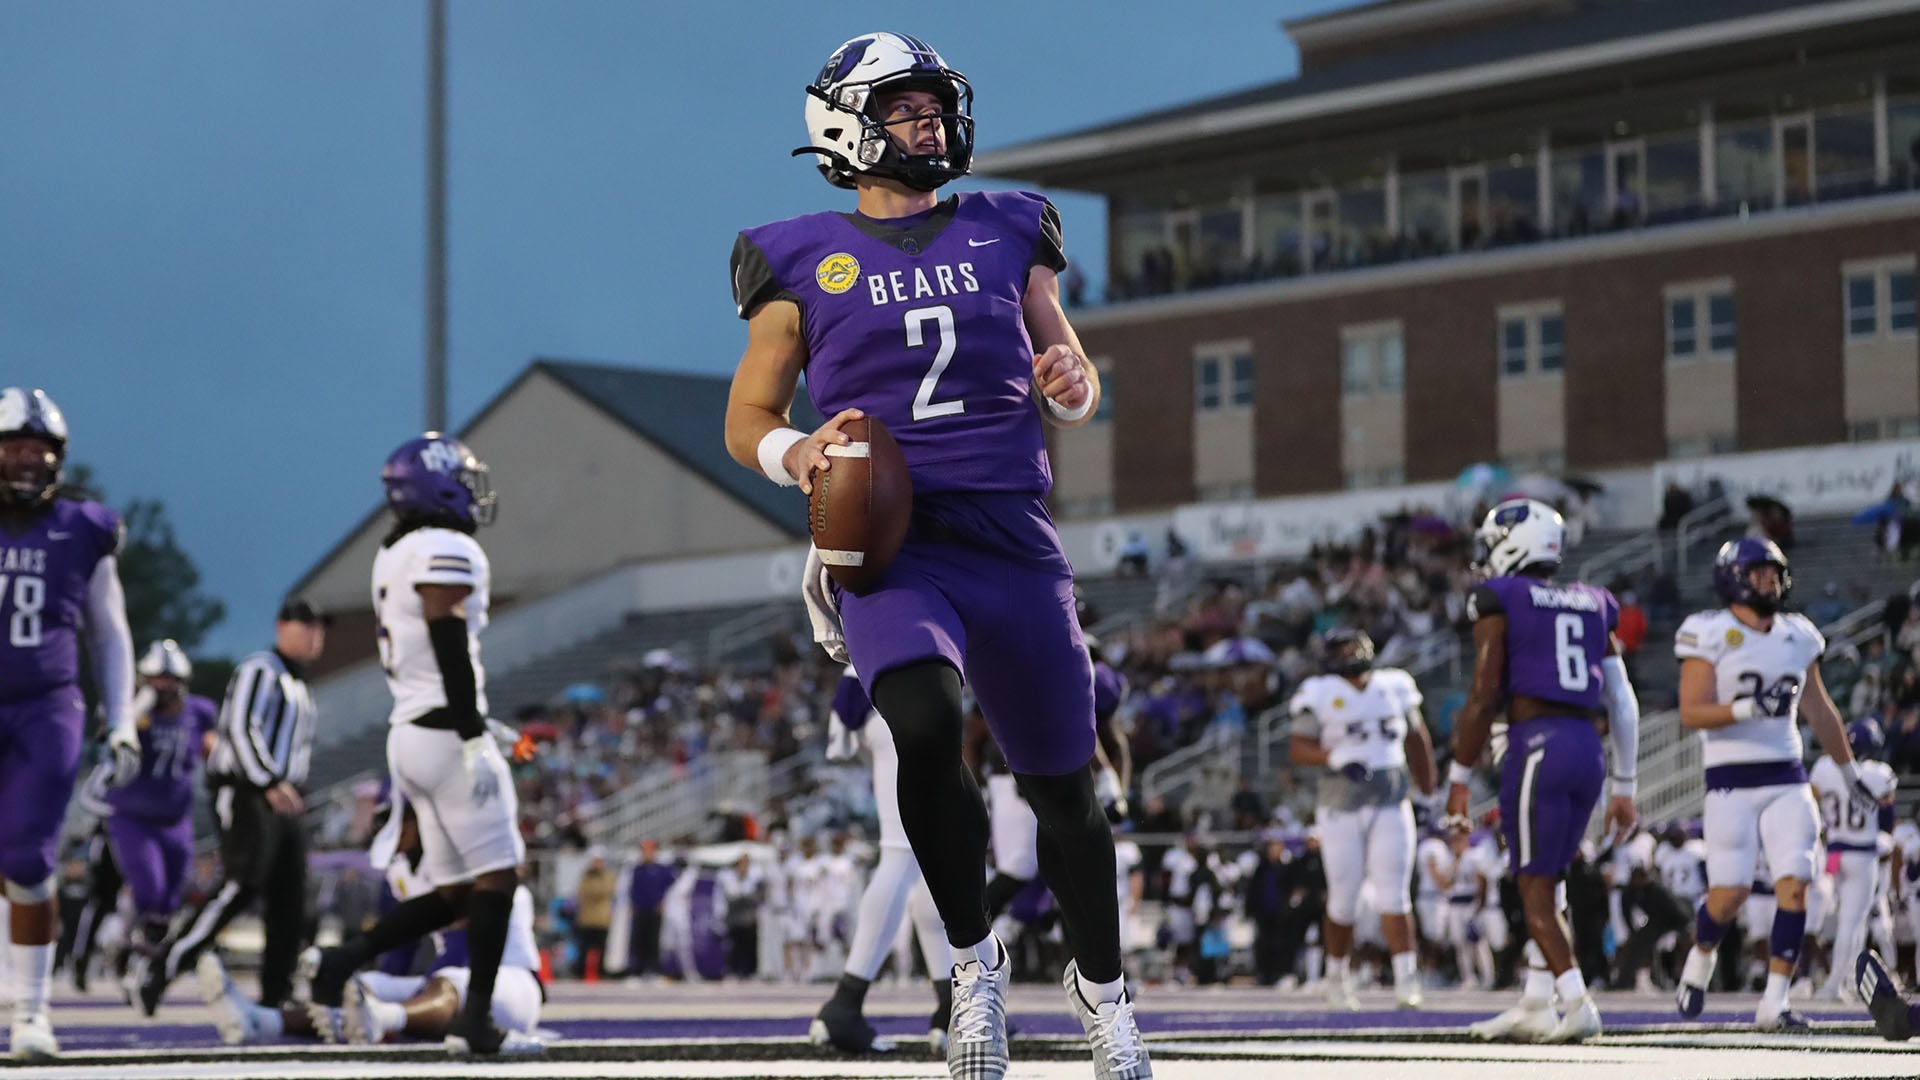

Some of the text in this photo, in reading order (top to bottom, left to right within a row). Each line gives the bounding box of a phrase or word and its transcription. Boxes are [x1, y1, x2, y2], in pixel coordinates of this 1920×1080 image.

[867, 262, 980, 306] BEARS
[904, 305, 966, 422] 2
[816, 475, 831, 532] Wilson
[1554, 612, 1589, 692] 6
